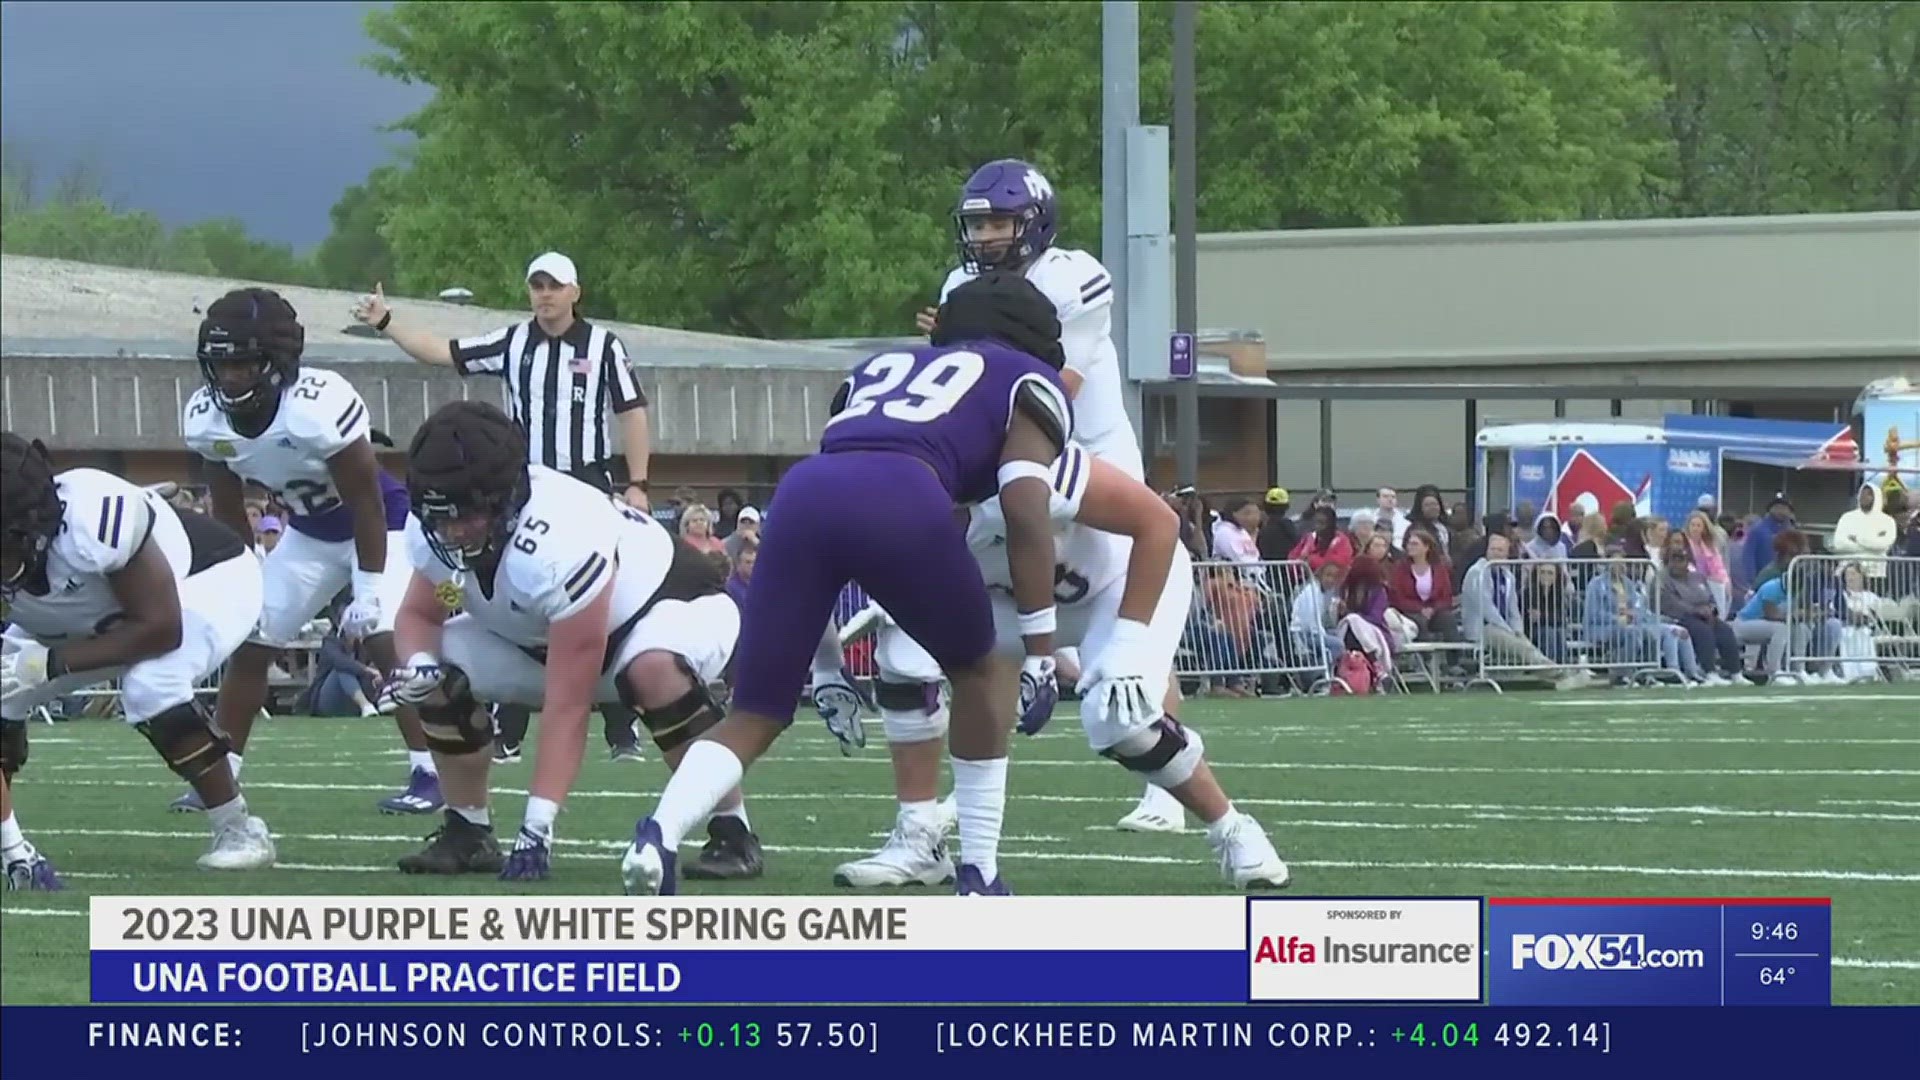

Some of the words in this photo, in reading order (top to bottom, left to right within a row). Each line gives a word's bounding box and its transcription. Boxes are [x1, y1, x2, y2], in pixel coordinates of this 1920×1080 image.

[294, 376, 327, 401] 22
[573, 386, 585, 403] R
[848, 351, 985, 422] 29
[514, 516, 550, 556] 65
